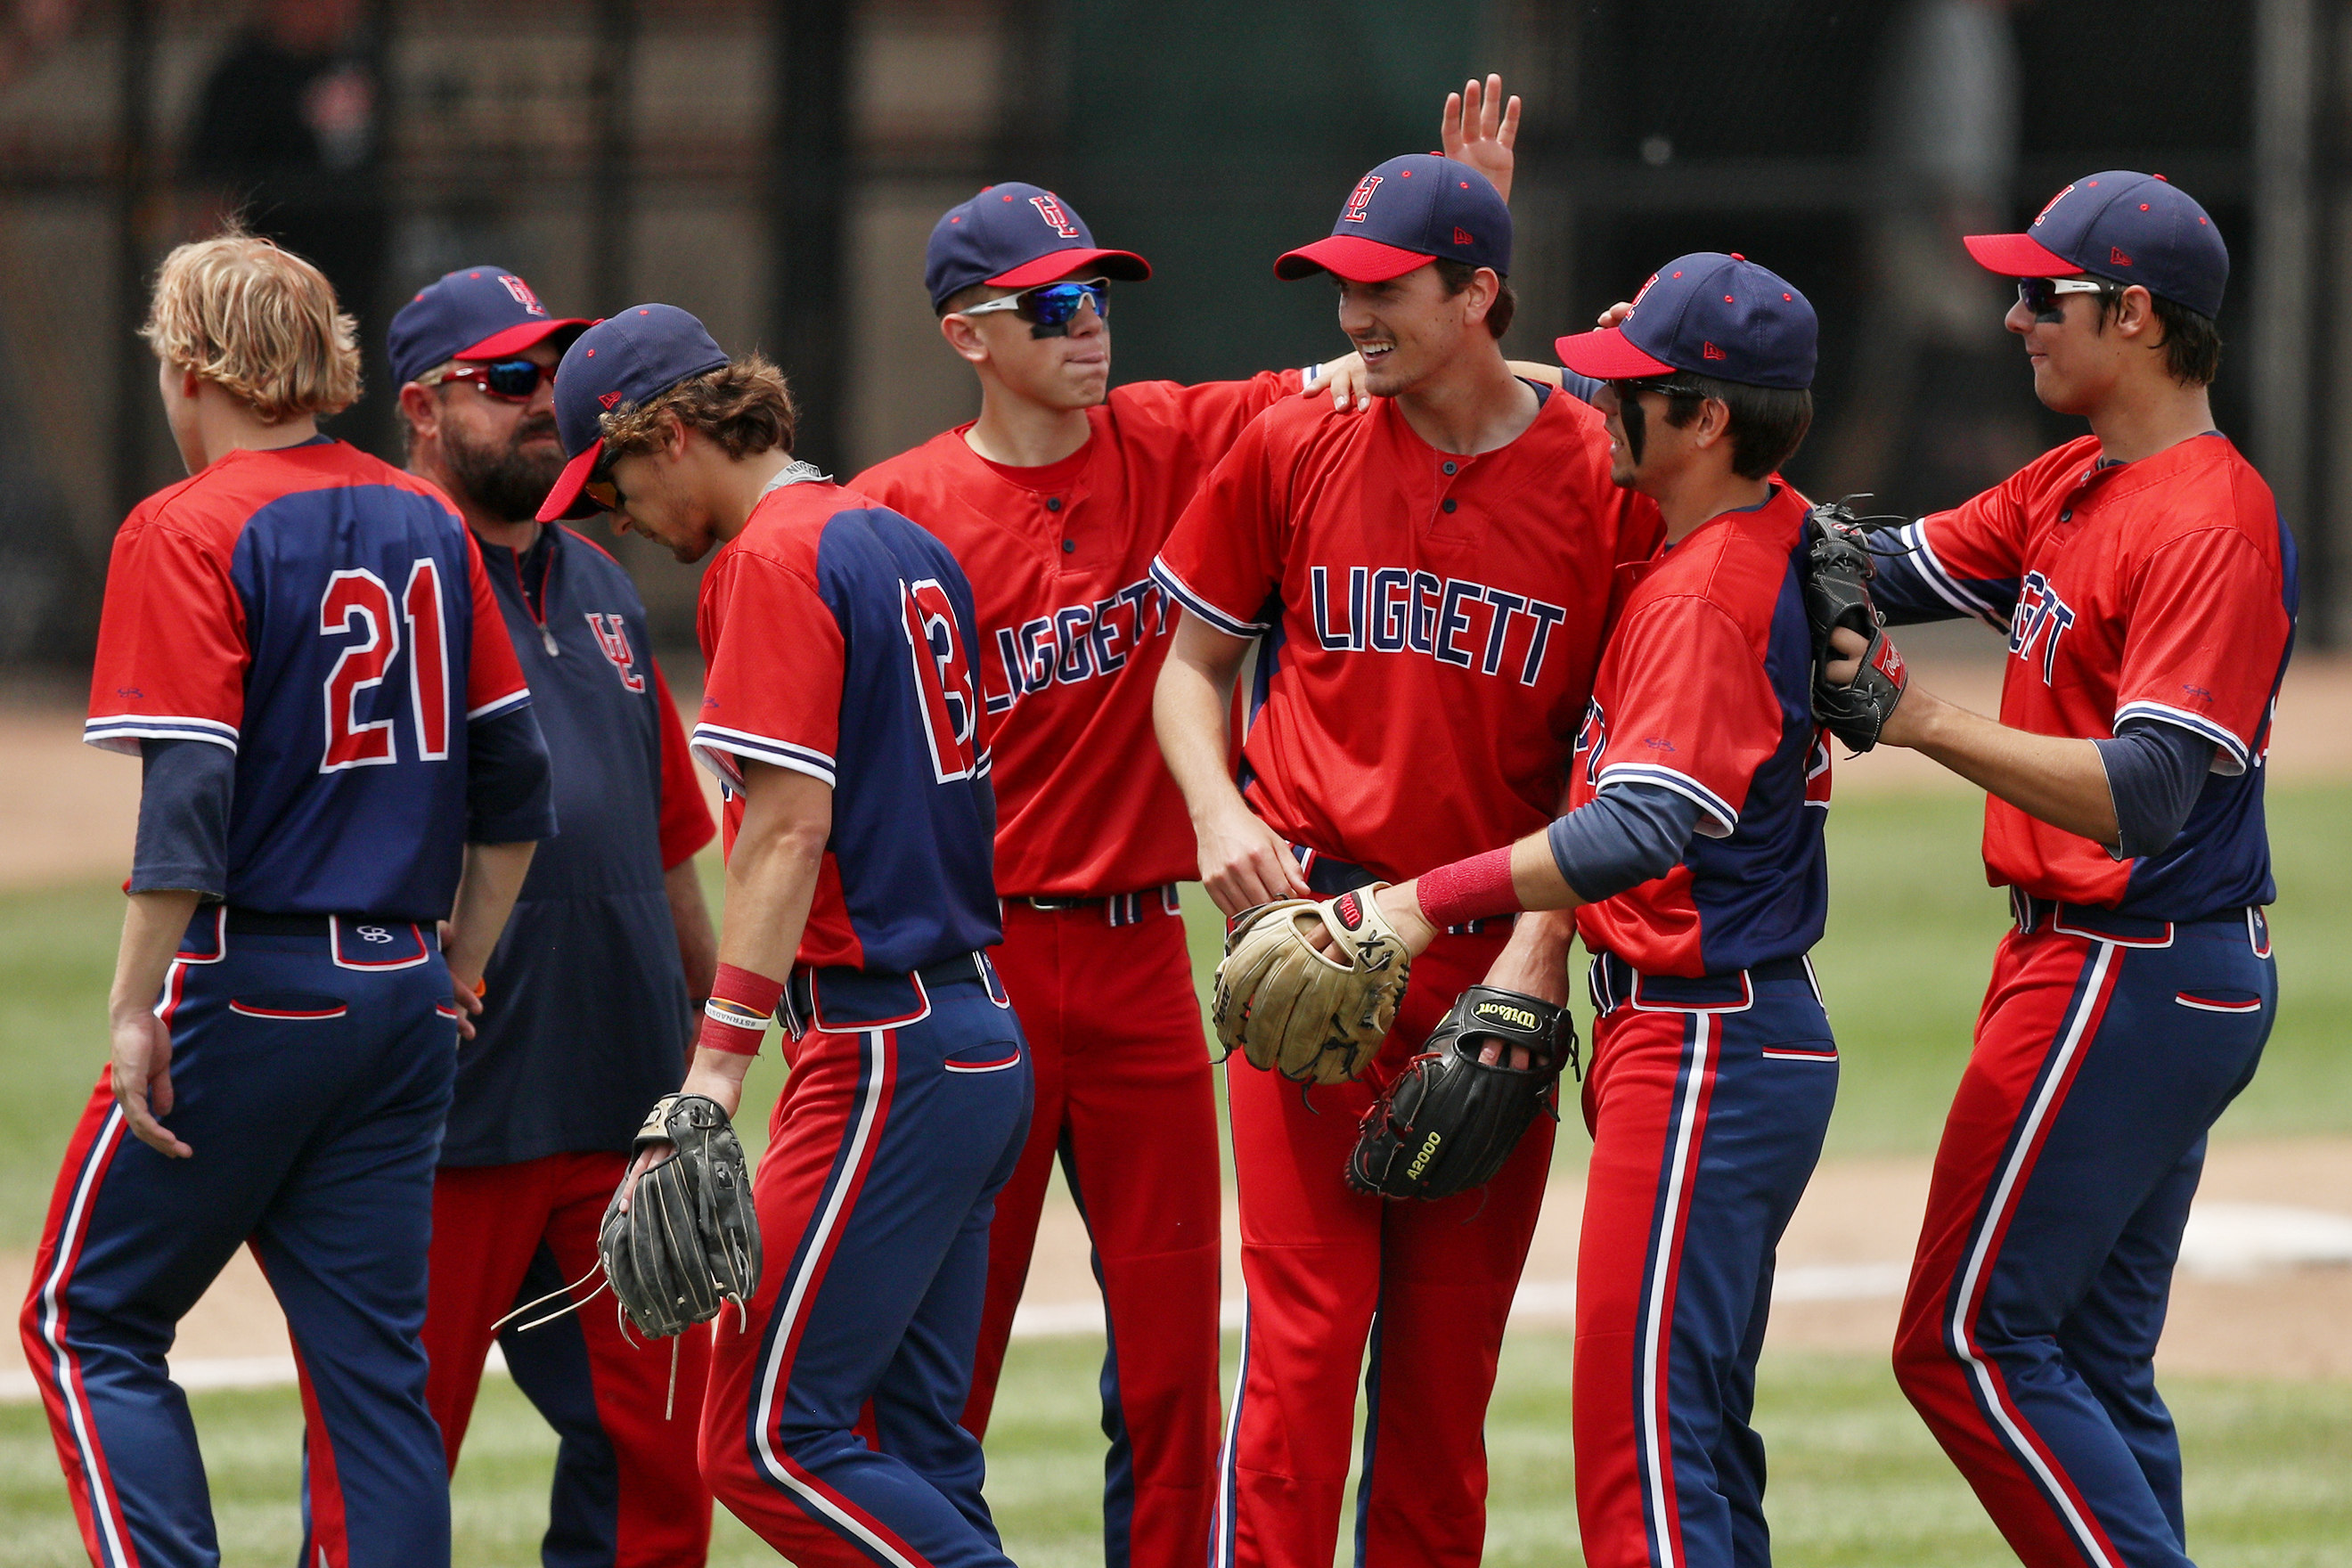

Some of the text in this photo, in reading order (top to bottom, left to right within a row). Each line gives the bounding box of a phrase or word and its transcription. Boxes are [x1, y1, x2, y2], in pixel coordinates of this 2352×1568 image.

[319, 557, 449, 773] 21
[899, 577, 976, 785] 13
[1311, 567, 1566, 687] LIGGETT
[1475, 1003, 1536, 1029] Wilson
[1407, 1131, 1441, 1180] A2000
